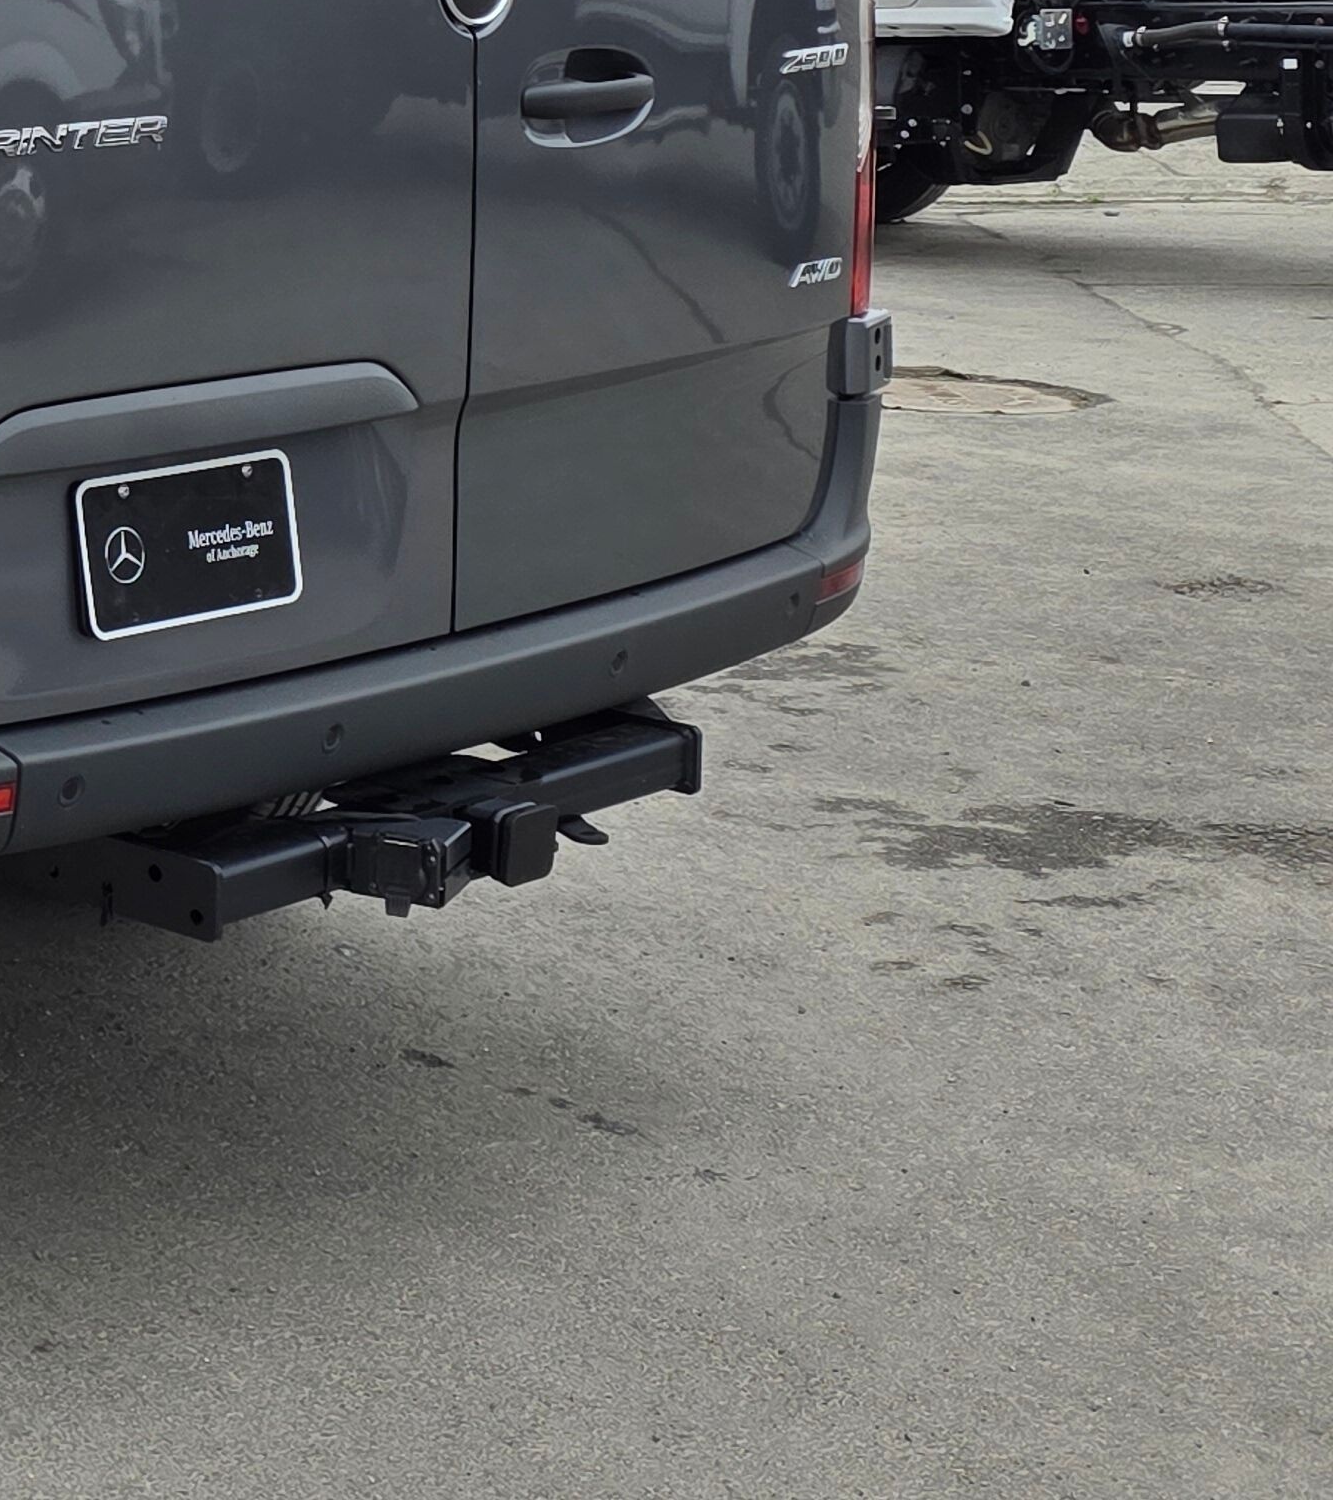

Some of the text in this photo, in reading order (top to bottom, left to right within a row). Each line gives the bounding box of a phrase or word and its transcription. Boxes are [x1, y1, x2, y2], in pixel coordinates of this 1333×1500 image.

[779, 42, 849, 75] 2500
[787, 257, 843, 288] AWD
[187, 520, 274, 550] Mercedes-Benz
[206, 544, 260, 563] of Anchorage
